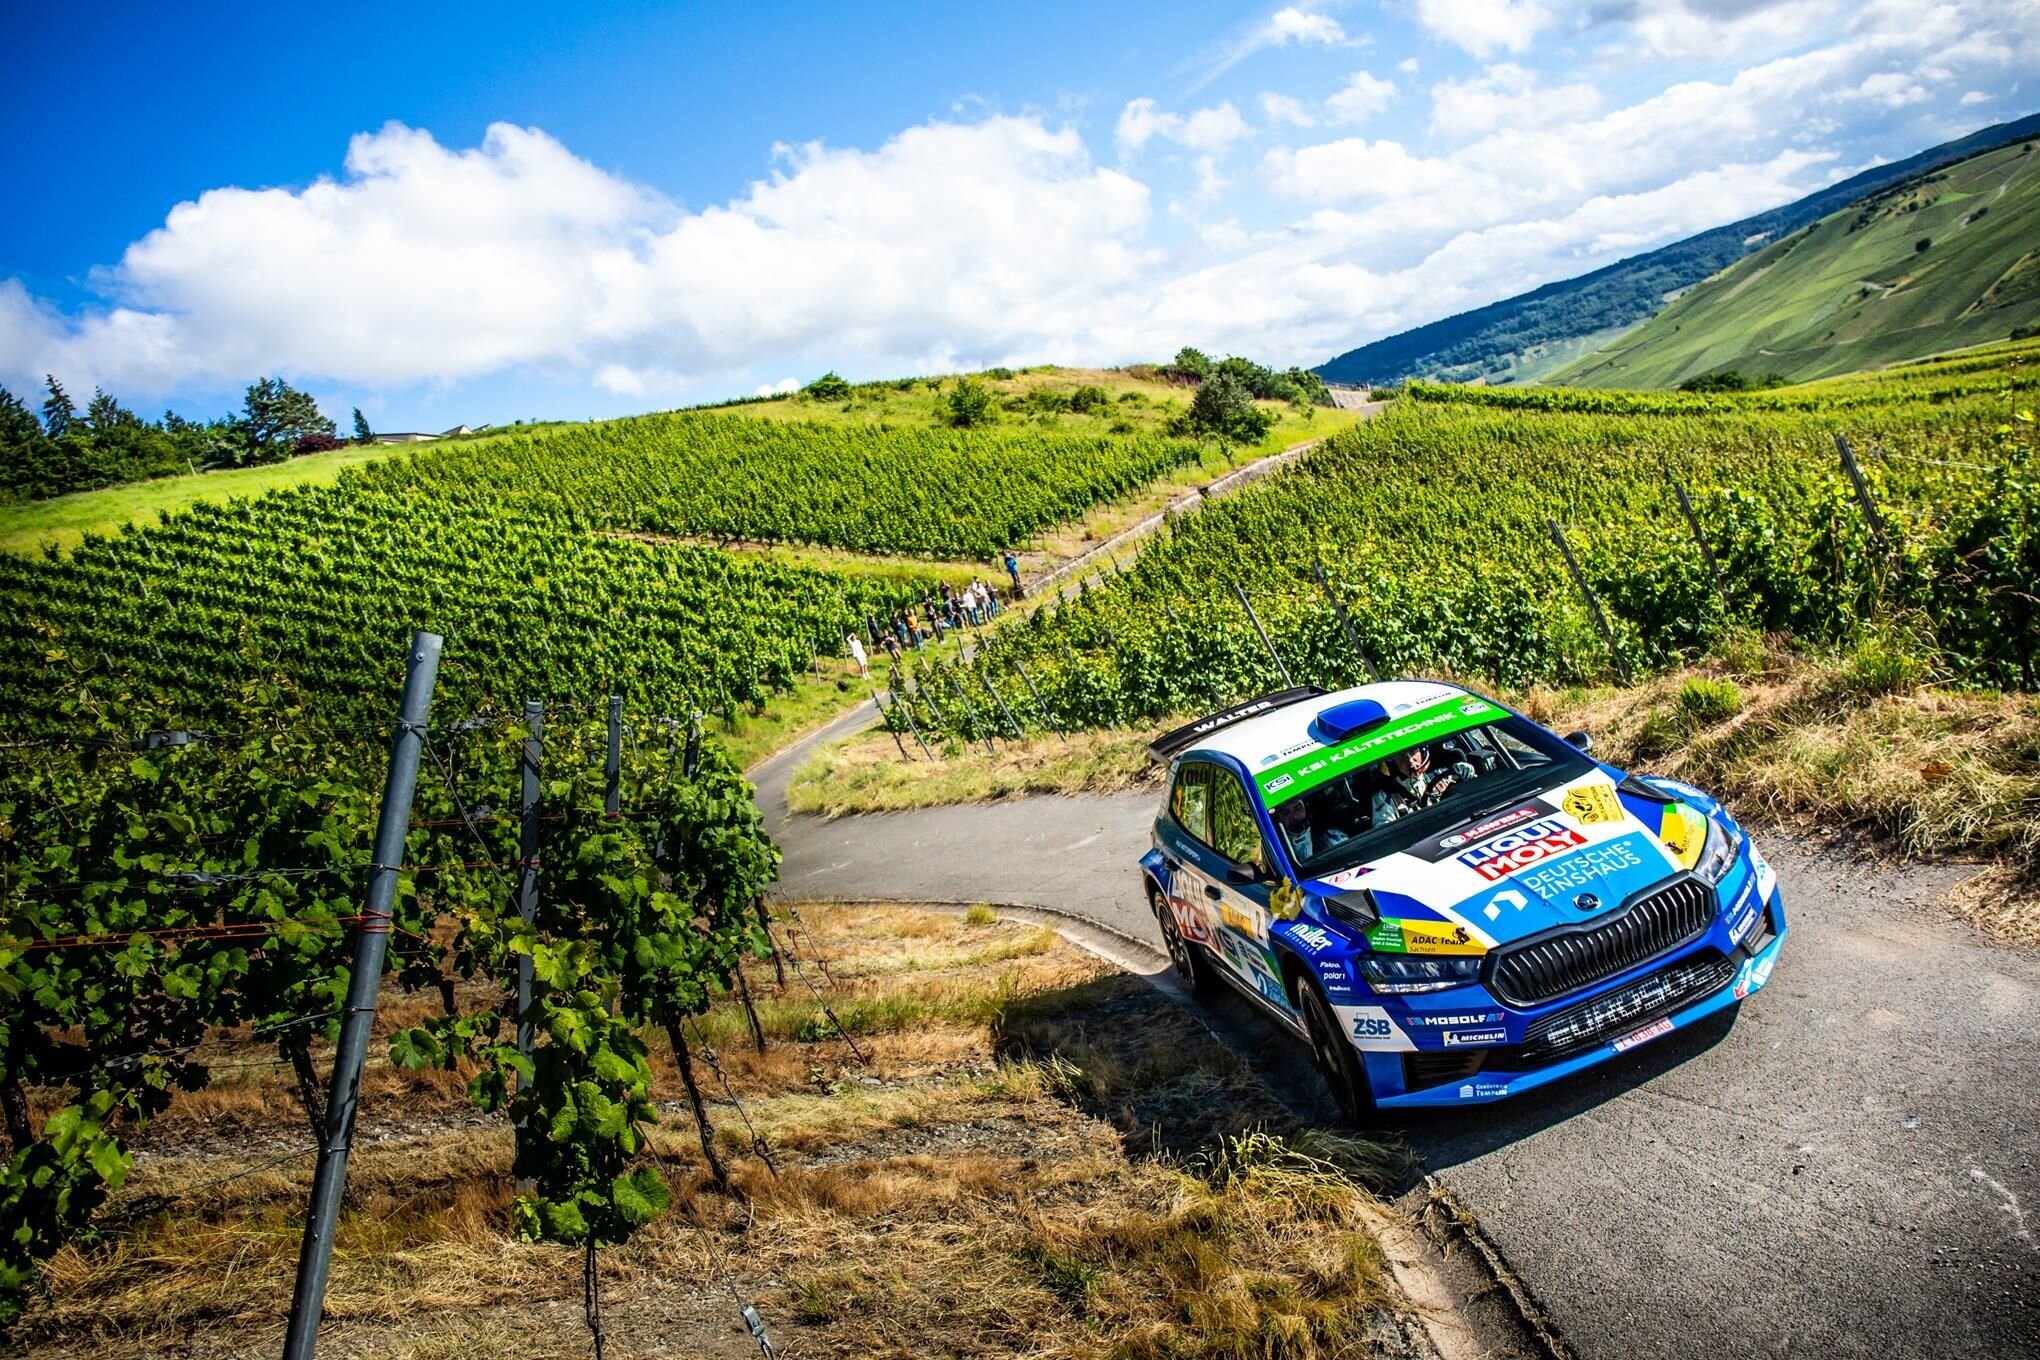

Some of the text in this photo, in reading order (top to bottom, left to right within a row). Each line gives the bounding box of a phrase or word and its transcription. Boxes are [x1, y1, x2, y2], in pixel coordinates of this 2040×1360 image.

[1193, 701, 1273, 732] WALTER
[1298, 760, 1328, 777] KSI
[1265, 776, 1291, 790] KSI
[1462, 820, 1564, 866] LIQUI
[1479, 830, 1578, 880] MOLY
[1523, 843, 1630, 889] DEUTSCHE
[1535, 853, 1642, 899] ZINSHAUS
[1411, 936, 1437, 945] ADAC
[1441, 937, 1465, 946] Team
[1353, 1018, 1392, 1036] ZSB
[1425, 1014, 1486, 1026] MOSOLF
[1461, 1032, 1505, 1042] MICHELIN
